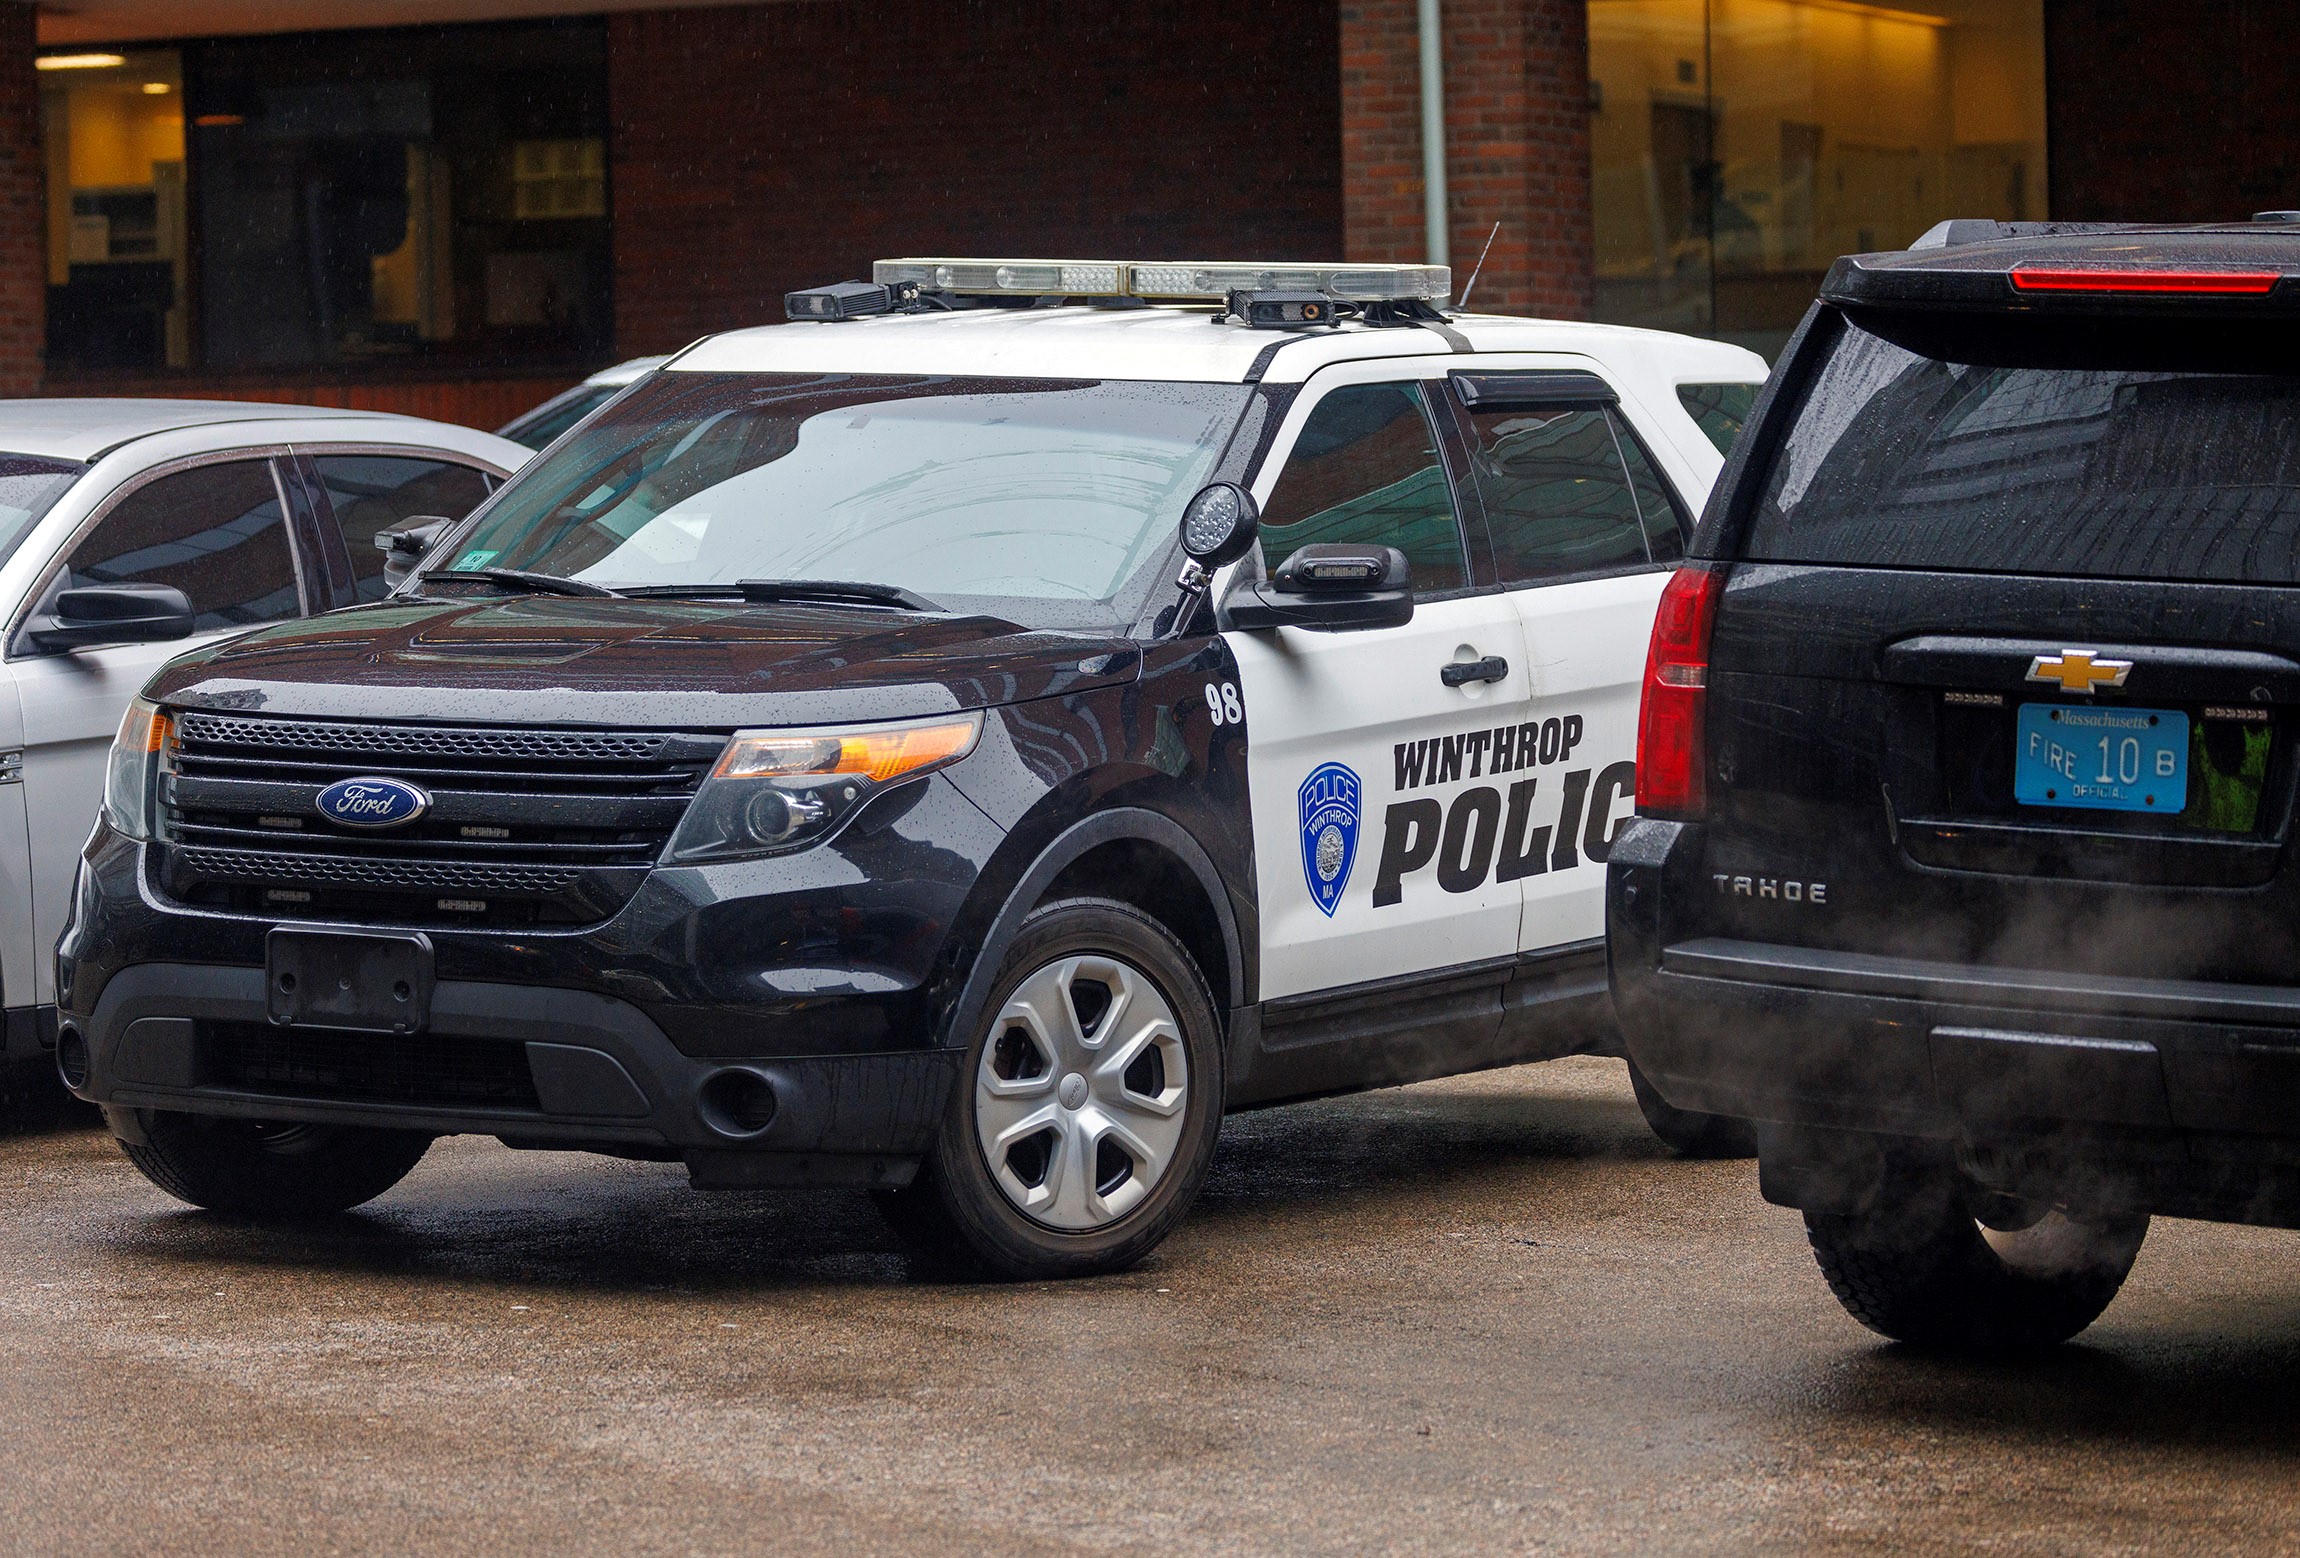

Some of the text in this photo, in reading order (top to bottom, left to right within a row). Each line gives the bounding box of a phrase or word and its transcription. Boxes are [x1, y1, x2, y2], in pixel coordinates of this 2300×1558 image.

[1205, 682, 1242, 726] 98
[2057, 709, 2149, 729] Massachusetts
[1394, 714, 1583, 791] WINTHROP
[2030, 731, 2175, 785] FIRE 10 B
[336, 785, 397, 815] Ford
[1305, 774, 1355, 819] POLICE
[2073, 784, 2128, 799] OFFICIAL
[1309, 809, 1353, 836] WINTHROP
[1372, 760, 1636, 908] POLIC
[1322, 884, 1334, 900] MA
[1713, 874, 1826, 904] TAHOE
